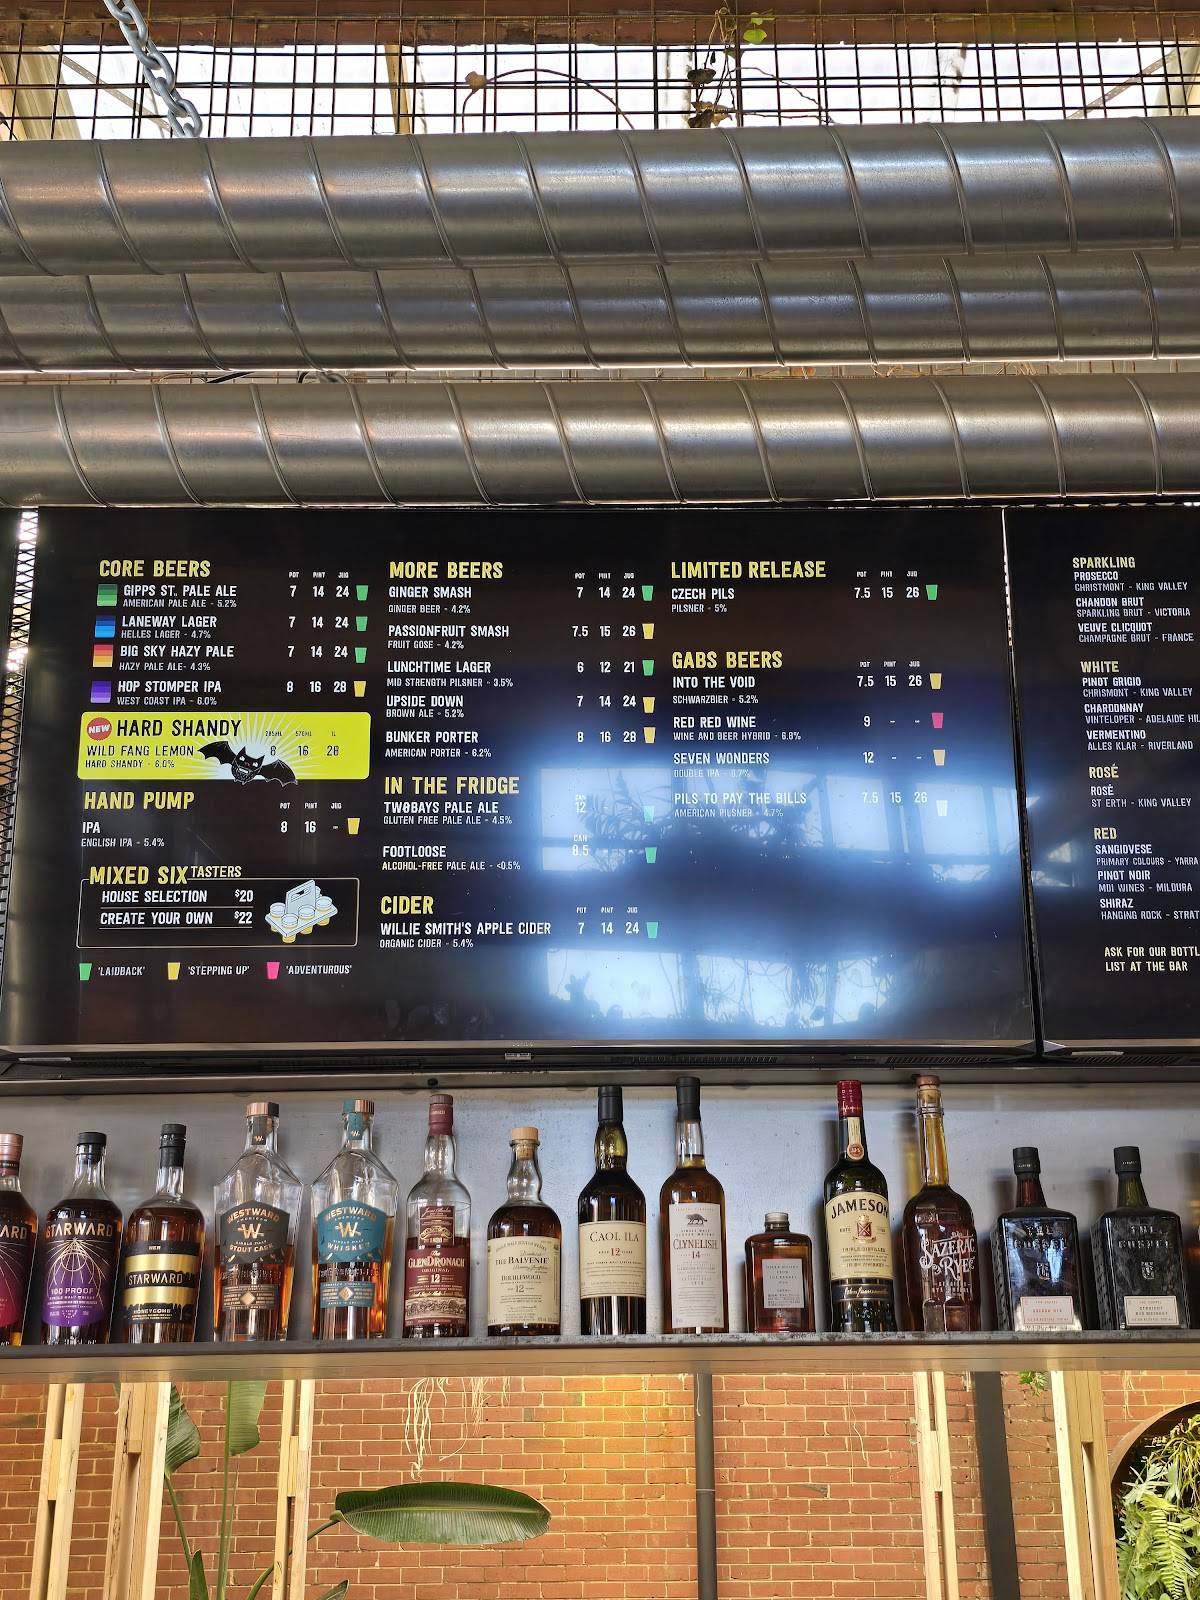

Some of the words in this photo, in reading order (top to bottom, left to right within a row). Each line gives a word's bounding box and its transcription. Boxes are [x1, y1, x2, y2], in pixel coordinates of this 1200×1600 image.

[1073, 557, 1135, 568] SPARKLING
[100, 560, 144, 577] CORE
[154, 560, 210, 577] BEERS
[390, 562, 438, 578] MORE
[448, 562, 503, 578] BEERS
[672, 562, 742, 578] LIMITED
[749, 561, 826, 578] RELEASE
[1074, 571, 1118, 581] PROSECCO
[124, 585, 156, 596] GIPPS
[161, 585, 177, 596] ST.
[183, 585, 210, 596] PALE
[216, 585, 237, 596] ALE
[389, 586, 428, 598] GINGER
[434, 587, 471, 598] SMASH
[672, 588, 706, 599] CZECH
[712, 588, 734, 599] PILS
[854, 588, 870, 598] 7.5
[882, 587, 893, 598] 15
[906, 587, 919, 598] 26
[1076, 598, 1117, 607] CHANDON
[1122, 597, 1144, 606] BRUT
[122, 616, 176, 627] LANEWAY
[182, 616, 217, 627] LAGER
[389, 625, 466, 637] PASSIONFRUIT
[471, 625, 508, 637] SMASH
[1078, 623, 1107, 632] VEUVE
[1111, 622, 1152, 633] CLICQUOT
[121, 646, 138, 656] BIG
[144, 645, 166, 657] SKY
[171, 646, 201, 657] HAZY
[206, 646, 234, 657] PALE
[672, 651, 717, 669] GABS
[726, 651, 782, 668] BEERS
[388, 661, 451, 672] LUNCHTIME
[456, 661, 491, 673] LAGER
[1080, 661, 1119, 673] WHITE
[118, 681, 140, 692] HOP
[145, 681, 198, 692] STOMPER
[204, 681, 221, 692] IPA
[287, 681, 293, 692] 8
[310, 681, 321, 692] 16
[334, 681, 346, 692] 28
[673, 677, 698, 688] INTO
[703, 676, 725, 688] THE
[730, 676, 755, 688] VOID
[1082, 677, 1108, 686] PINOT
[1113, 677, 1141, 686] GRIGIO
[1083, 688, 1128, 697] CHRISMONT
[1140, 688, 1159, 696] KING
[1162, 688, 1192, 696] VALLEY
[387, 695, 425, 706] UPSIDE
[431, 696, 463, 707] DOWN
[1084, 703, 1143, 713] CHARDONNAY
[674, 717, 694, 728] RED
[700, 716, 721, 728] RED
[726, 716, 756, 728] WINE
[88, 724, 112, 734] NEW
[118, 720, 162, 736] HARD
[172, 720, 241, 736] SHANDY
[386, 731, 430, 742] BUNKER
[436, 731, 478, 743] PORTER
[1086, 730, 1146, 740] VERMENTINO
[88, 746, 114, 756] WILD
[121, 746, 149, 756] FANG
[156, 746, 193, 756] LEMON
[674, 753, 710, 764] SEVEN
[716, 753, 769, 764] WONDERS
[1089, 763, 1118, 778] ROSÉ
[385, 777, 402, 794] IN
[412, 777, 447, 794] THE
[457, 777, 519, 794] FRIDGE
[1091, 784, 1114, 796] ROSÉ
[85, 792, 134, 809] HAND
[144, 792, 194, 809] PUMP
[675, 793, 698, 804] PILS
[704, 793, 717, 804] TO
[723, 793, 742, 804] PAY
[749, 793, 770, 804] THE
[776, 793, 806, 804] BILLS
[445, 802, 472, 813] PALE
[478, 802, 498, 813] ALE
[384, 816, 414, 824] GLUTEN
[418, 816, 438, 824] FREE
[443, 816, 462, 824] PALE
[466, 816, 481, 824] ALE
[83, 822, 100, 833] IPA
[1094, 828, 1116, 840] RED
[383, 846, 446, 857] FOOTLOOSE
[1095, 844, 1152, 854] SANGIOVESE
[88, 866, 149, 884] MIXED
[158, 866, 189, 884] SIX
[191, 866, 242, 877] TASTERS
[1098, 870, 1124, 880] PINOT
[1129, 870, 1150, 880] NOIR
[102, 891, 139, 902] HOUSE
[144, 890, 207, 902] SELECTION
[235, 889, 253, 902] $20
[381, 896, 433, 914] CIDER
[1100, 898, 1134, 908] SHIRAZ
[101, 912, 145, 924] CREATE
[152, 912, 180, 924] YOUR
[186, 912, 212, 924] OWN
[234, 911, 252, 924] $22
[381, 923, 420, 935] WILLIE
[425, 922, 471, 935] SMITH'S
[477, 922, 513, 934] APPLE
[518, 922, 550, 934] CIDER
[1105, 947, 1122, 957] ASK
[1127, 947, 1144, 957] FOR
[1149, 947, 1166, 956] OUR
[1106, 962, 1125, 971] LIST
[1130, 962, 1142, 971] AT
[1146, 962, 1165, 971] THE
[1169, 961, 1188, 971] BAR
[832, 1199, 888, 1219] JAMESON
[227, 1208, 280, 1223] WESTWARD
[46, 1223, 112, 1238] STARWARD
[590, 1232, 620, 1242] CAOL
[625, 1232, 639, 1242] ILA
[673, 1239, 718, 1249] CLYNELISH
[611, 1248, 620, 1256] 12
[692, 1251, 700, 1259] 14
[920, 1238, 975, 1269] SAZERAC
[129, 1273, 182, 1285] STARWARD
[431, 1274, 440, 1283] 12
